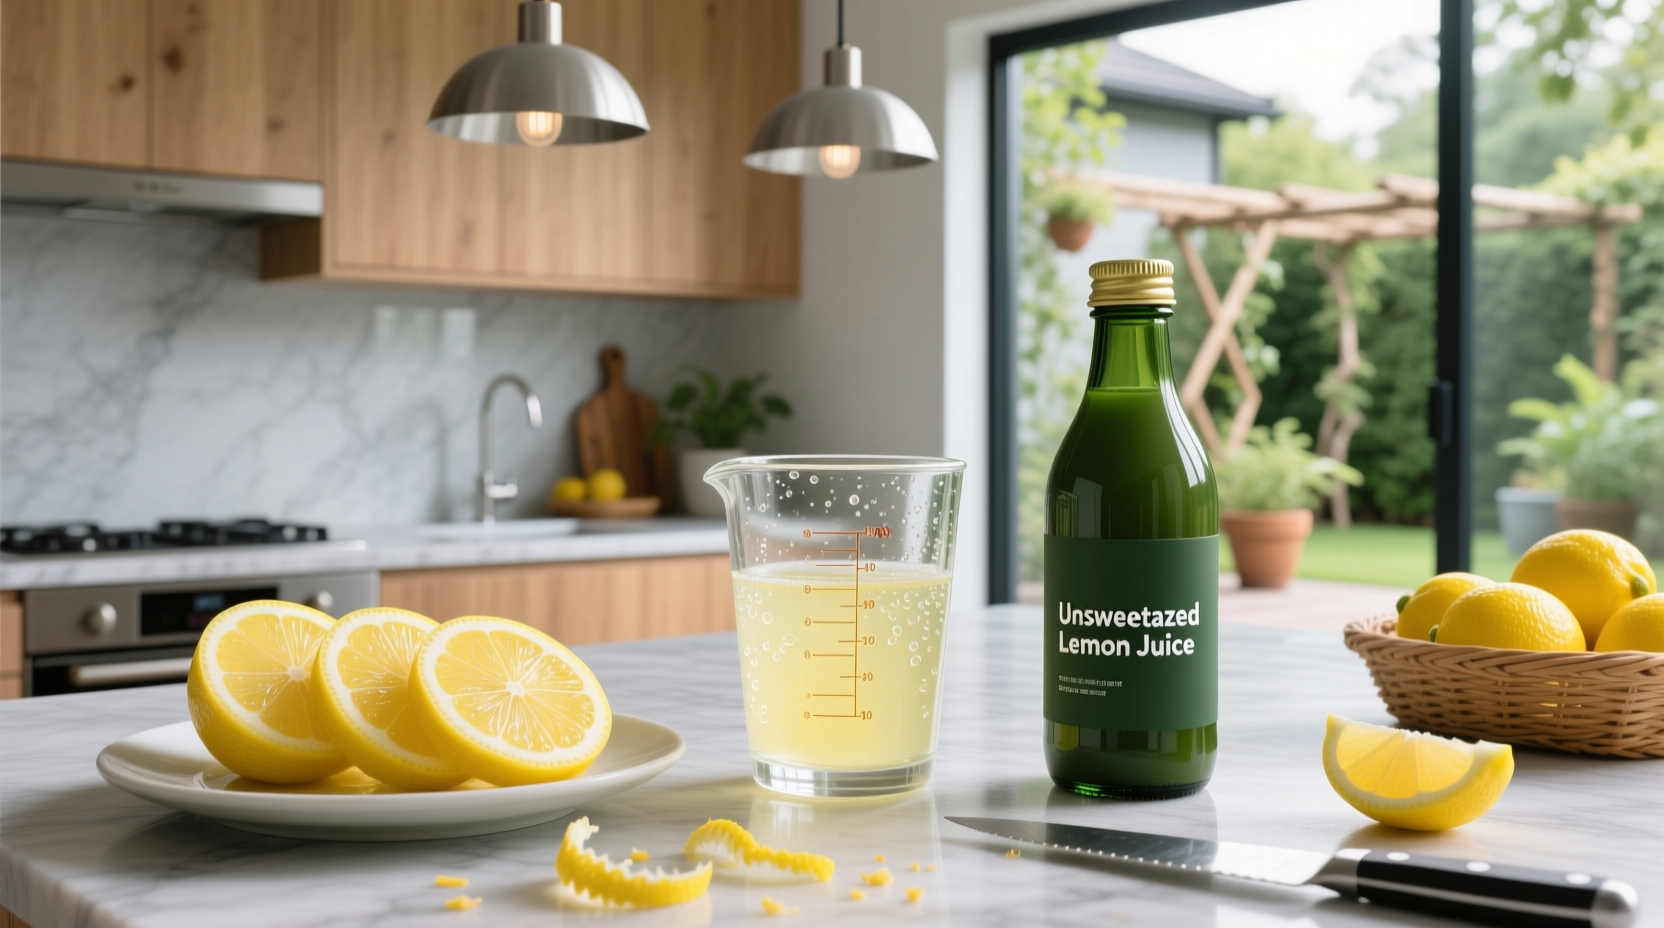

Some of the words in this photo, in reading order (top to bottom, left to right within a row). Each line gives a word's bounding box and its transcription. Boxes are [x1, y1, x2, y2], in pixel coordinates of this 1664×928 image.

[1059, 601, 1200, 628] Unsweetazed
[1059, 630, 1131, 657] Lemon
[1136, 632, 1195, 657] Juice
